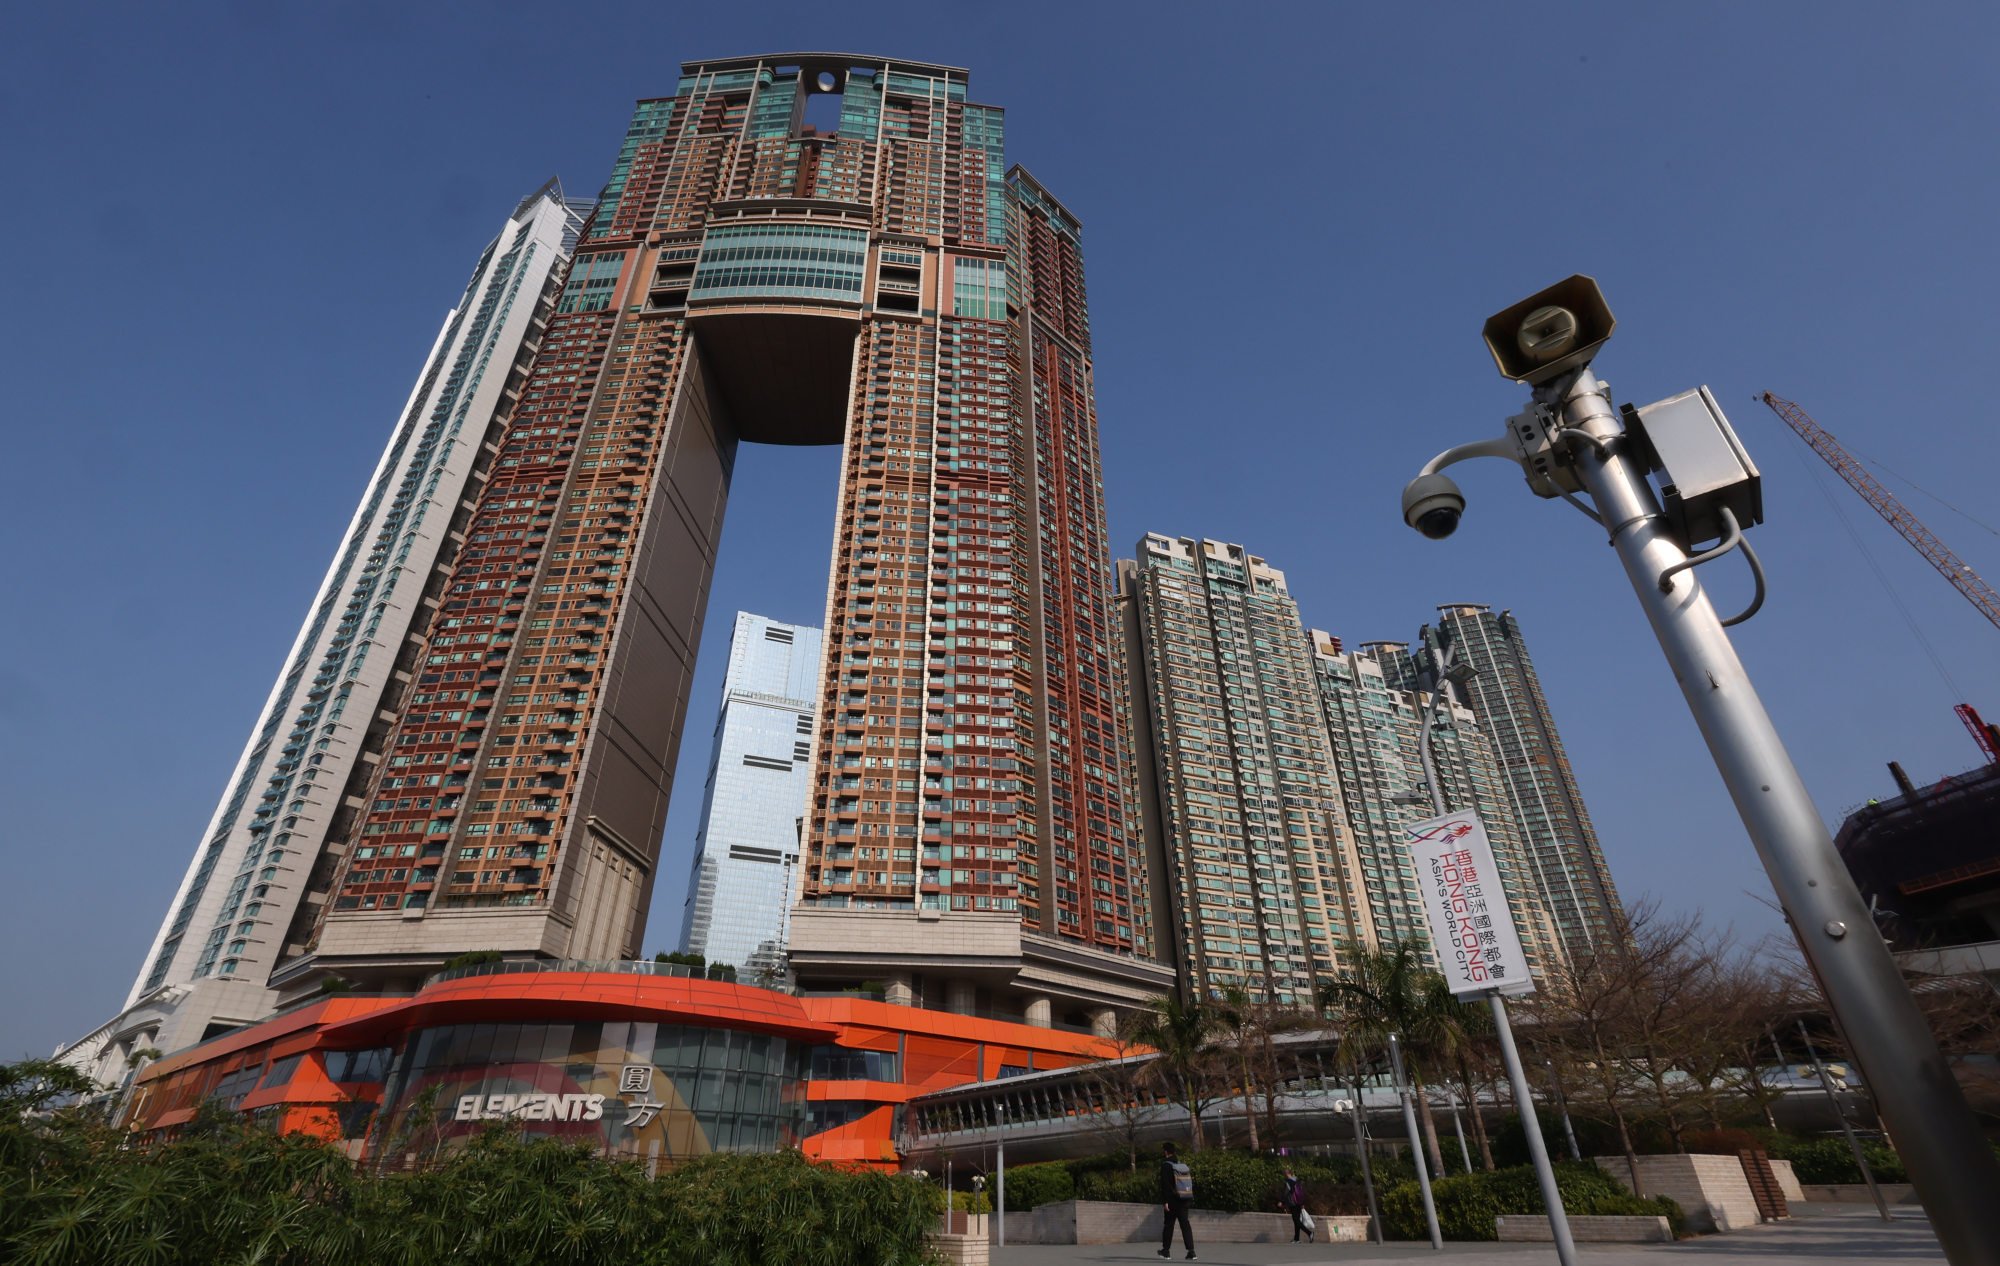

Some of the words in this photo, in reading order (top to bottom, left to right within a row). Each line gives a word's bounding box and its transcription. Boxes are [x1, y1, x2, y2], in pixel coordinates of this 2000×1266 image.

[1429, 857, 1448, 897] ASIA'S
[1441, 900, 1462, 948] WORLD
[1455, 950, 1473, 982] CITY
[1439, 853, 1469, 914] HONG
[1457, 917, 1489, 983] KONG
[454, 1093, 606, 1122] ELEMENTS
